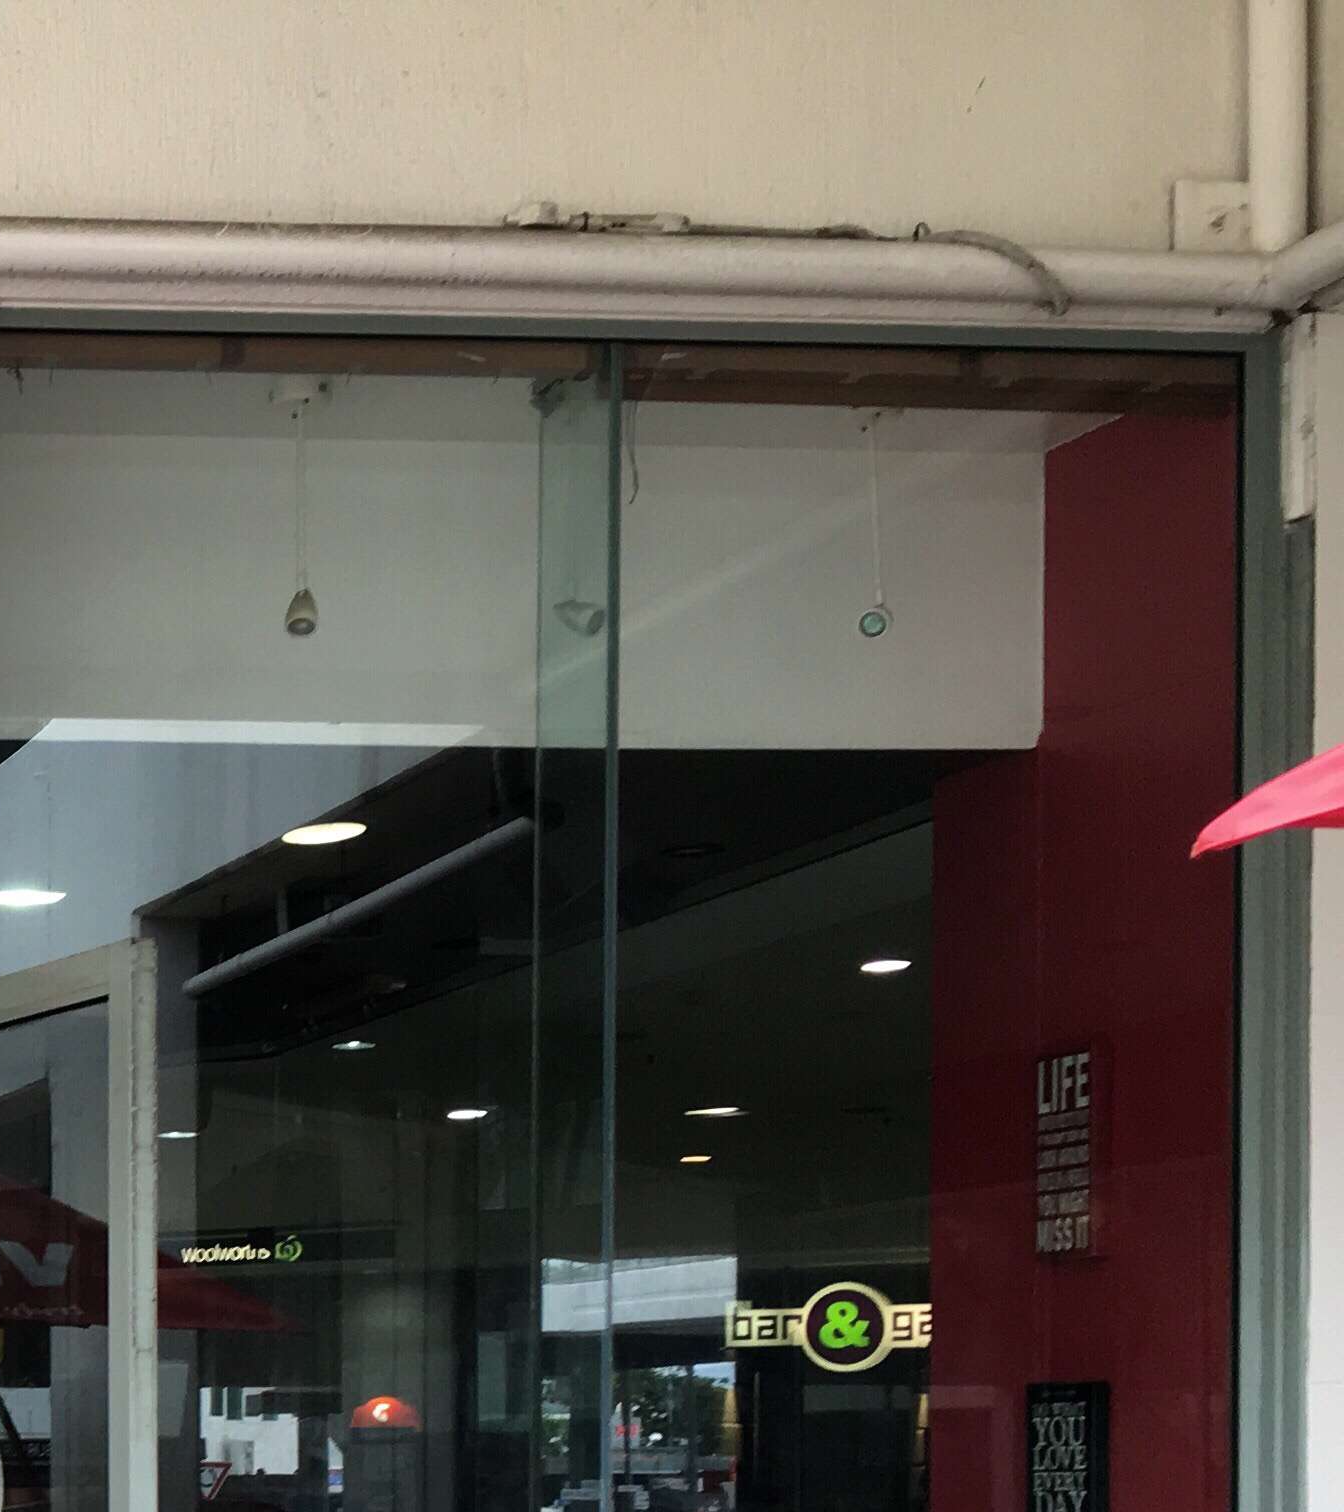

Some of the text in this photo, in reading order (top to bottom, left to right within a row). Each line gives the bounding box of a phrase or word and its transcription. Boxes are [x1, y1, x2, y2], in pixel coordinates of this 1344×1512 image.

[1037, 1051, 1090, 1115] LIFE
[818, 1300, 872, 1349] &
[1032, 1415, 1086, 1445] YOU
[1032, 1442, 1087, 1470] LOVE
